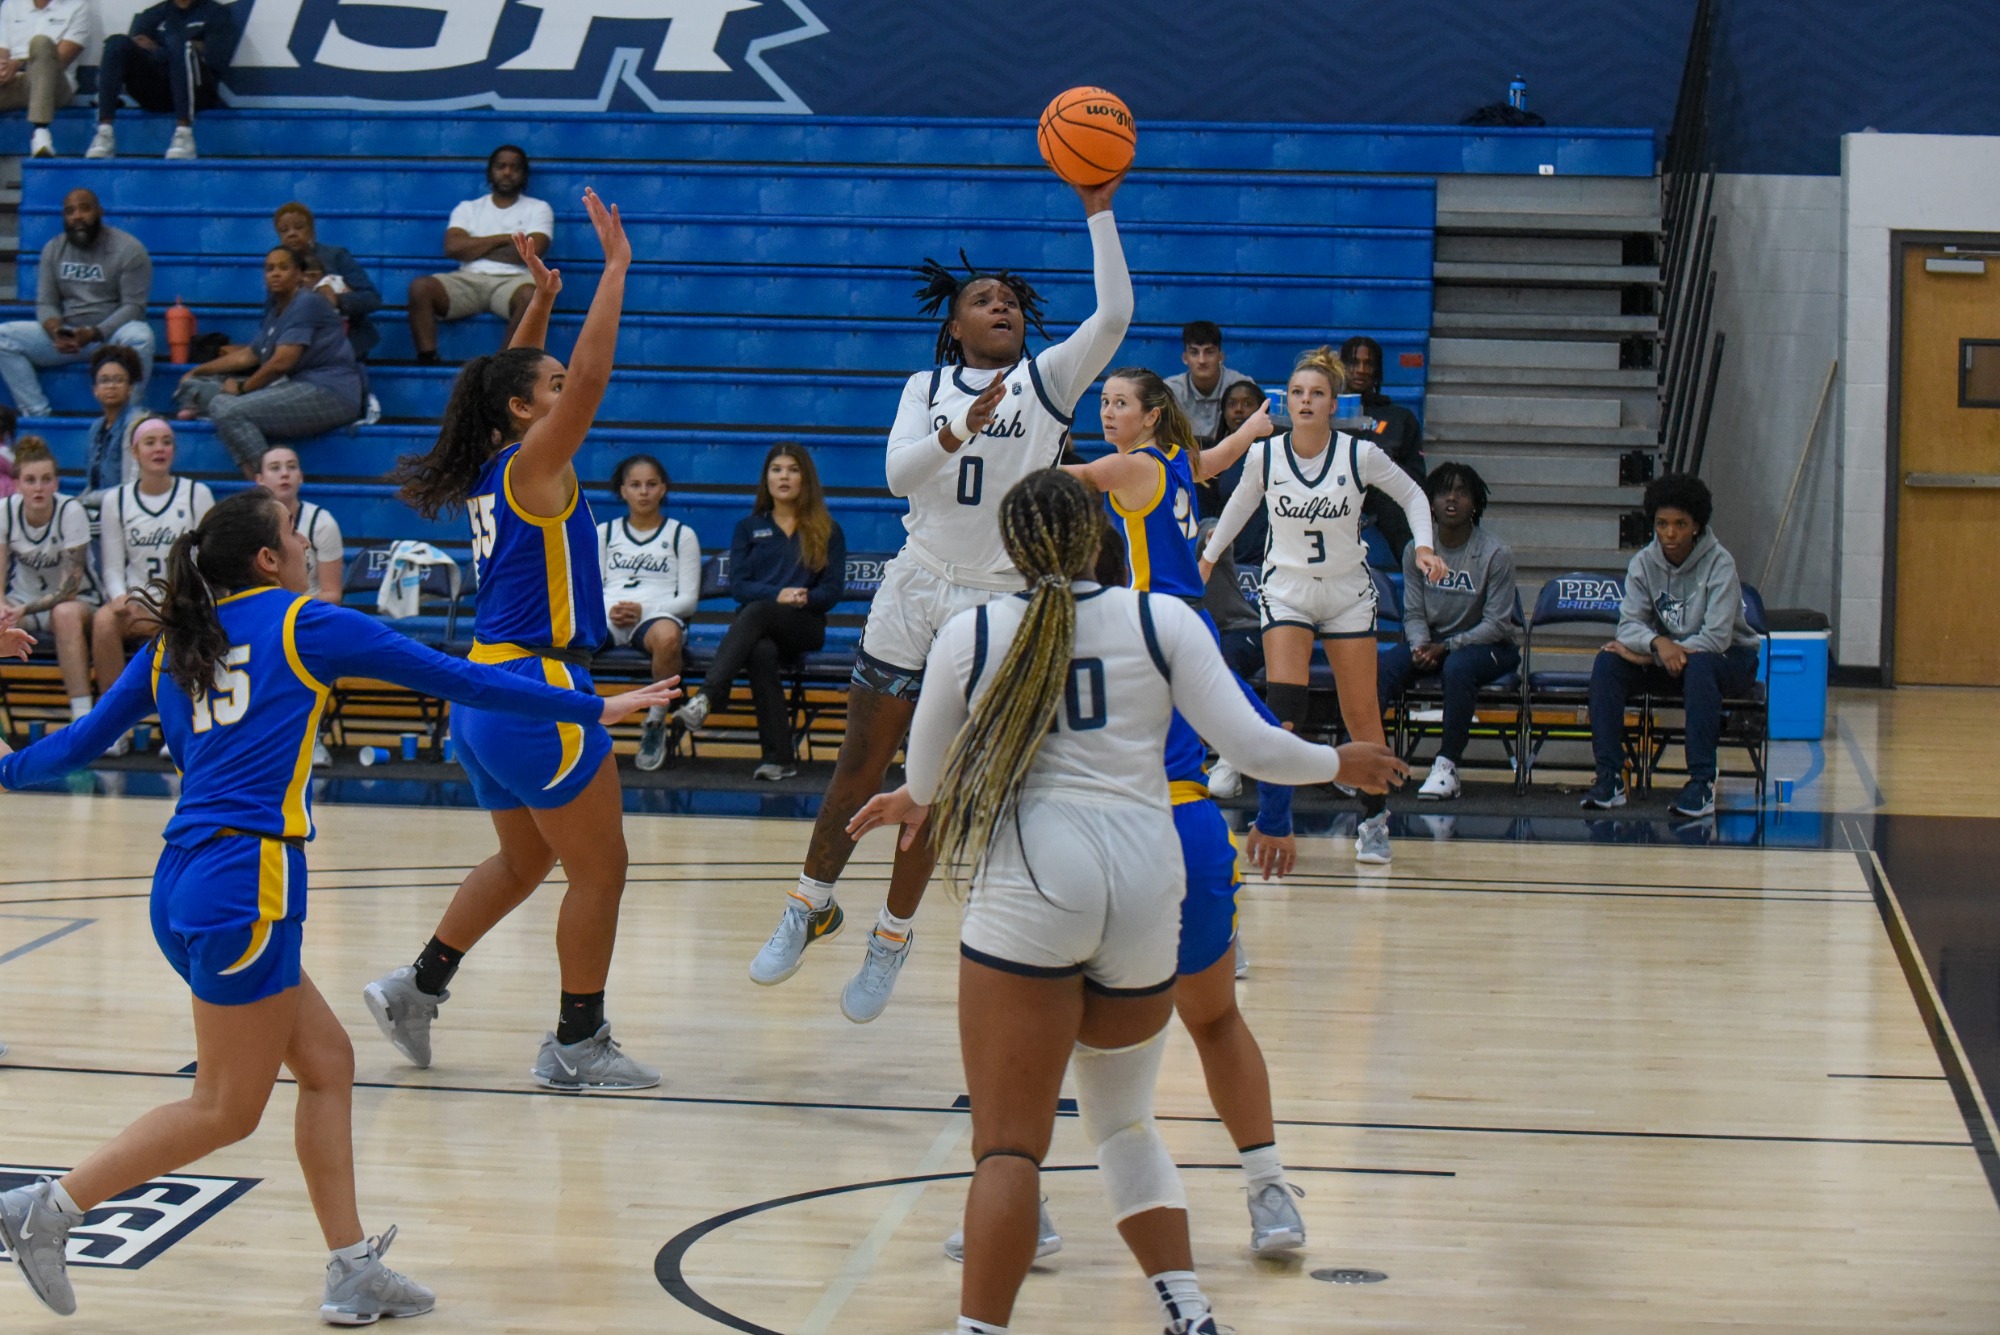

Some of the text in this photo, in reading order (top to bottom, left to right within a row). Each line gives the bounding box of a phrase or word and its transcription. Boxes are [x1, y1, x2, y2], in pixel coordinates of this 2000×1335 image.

[61, 261, 106, 281] PBA
[957, 455, 983, 506] 0
[1274, 495, 1351, 524] Sailfish
[466, 492, 497, 561] 55
[1304, 529, 1326, 564] 3
[609, 551, 670, 575] Sailfish
[1425, 569, 1476, 592] BA
[1556, 580, 1624, 601] PBA
[192, 643, 251, 733] 15
